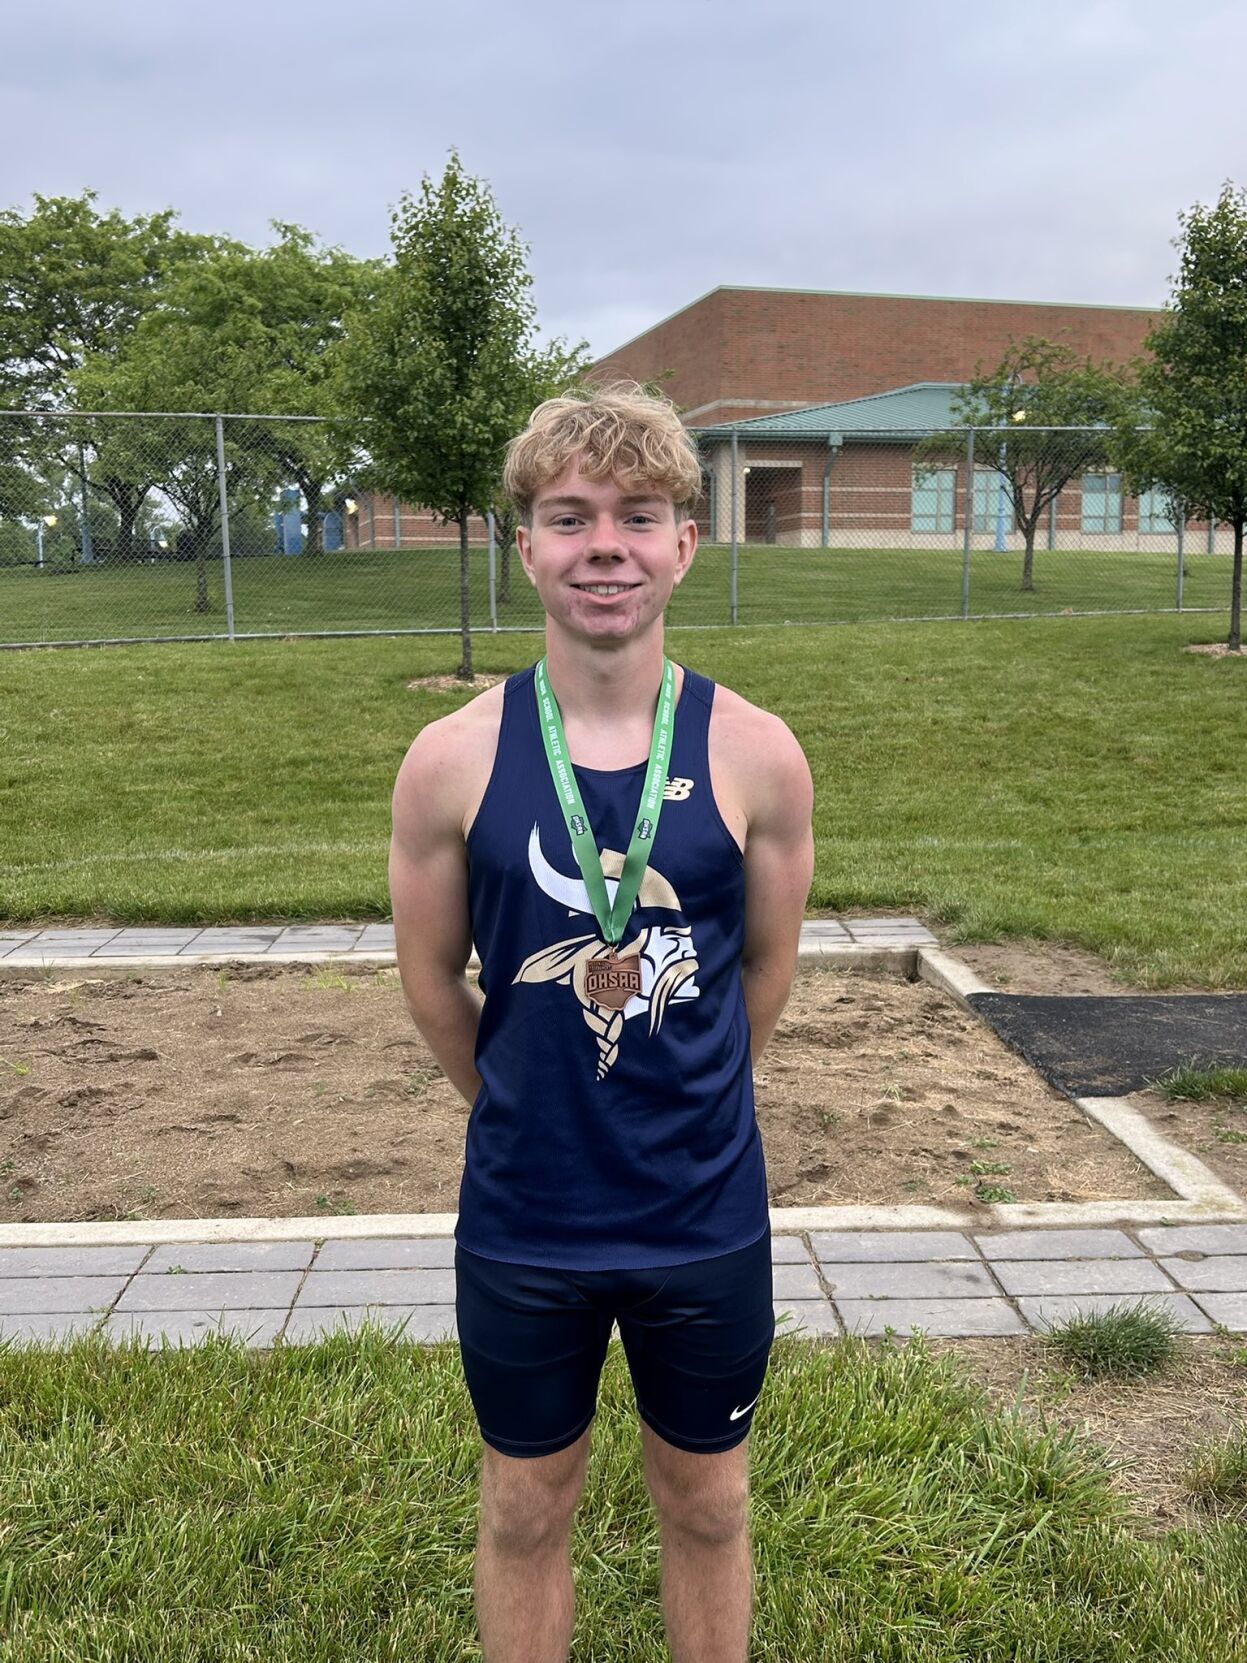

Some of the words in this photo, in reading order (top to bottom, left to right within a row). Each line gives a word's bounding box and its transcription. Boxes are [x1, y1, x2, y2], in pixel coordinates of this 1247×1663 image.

[661, 701, 670, 725] SCHOOL
[542, 697, 554, 722] SCHOOL
[548, 725, 562, 757] ATHLETIC
[555, 759, 576, 805] ASSOCIATION
[655, 728, 667, 761] ATHLETIC
[646, 763, 663, 810] ASSOCIATION
[588, 972, 639, 991] OHSAA
